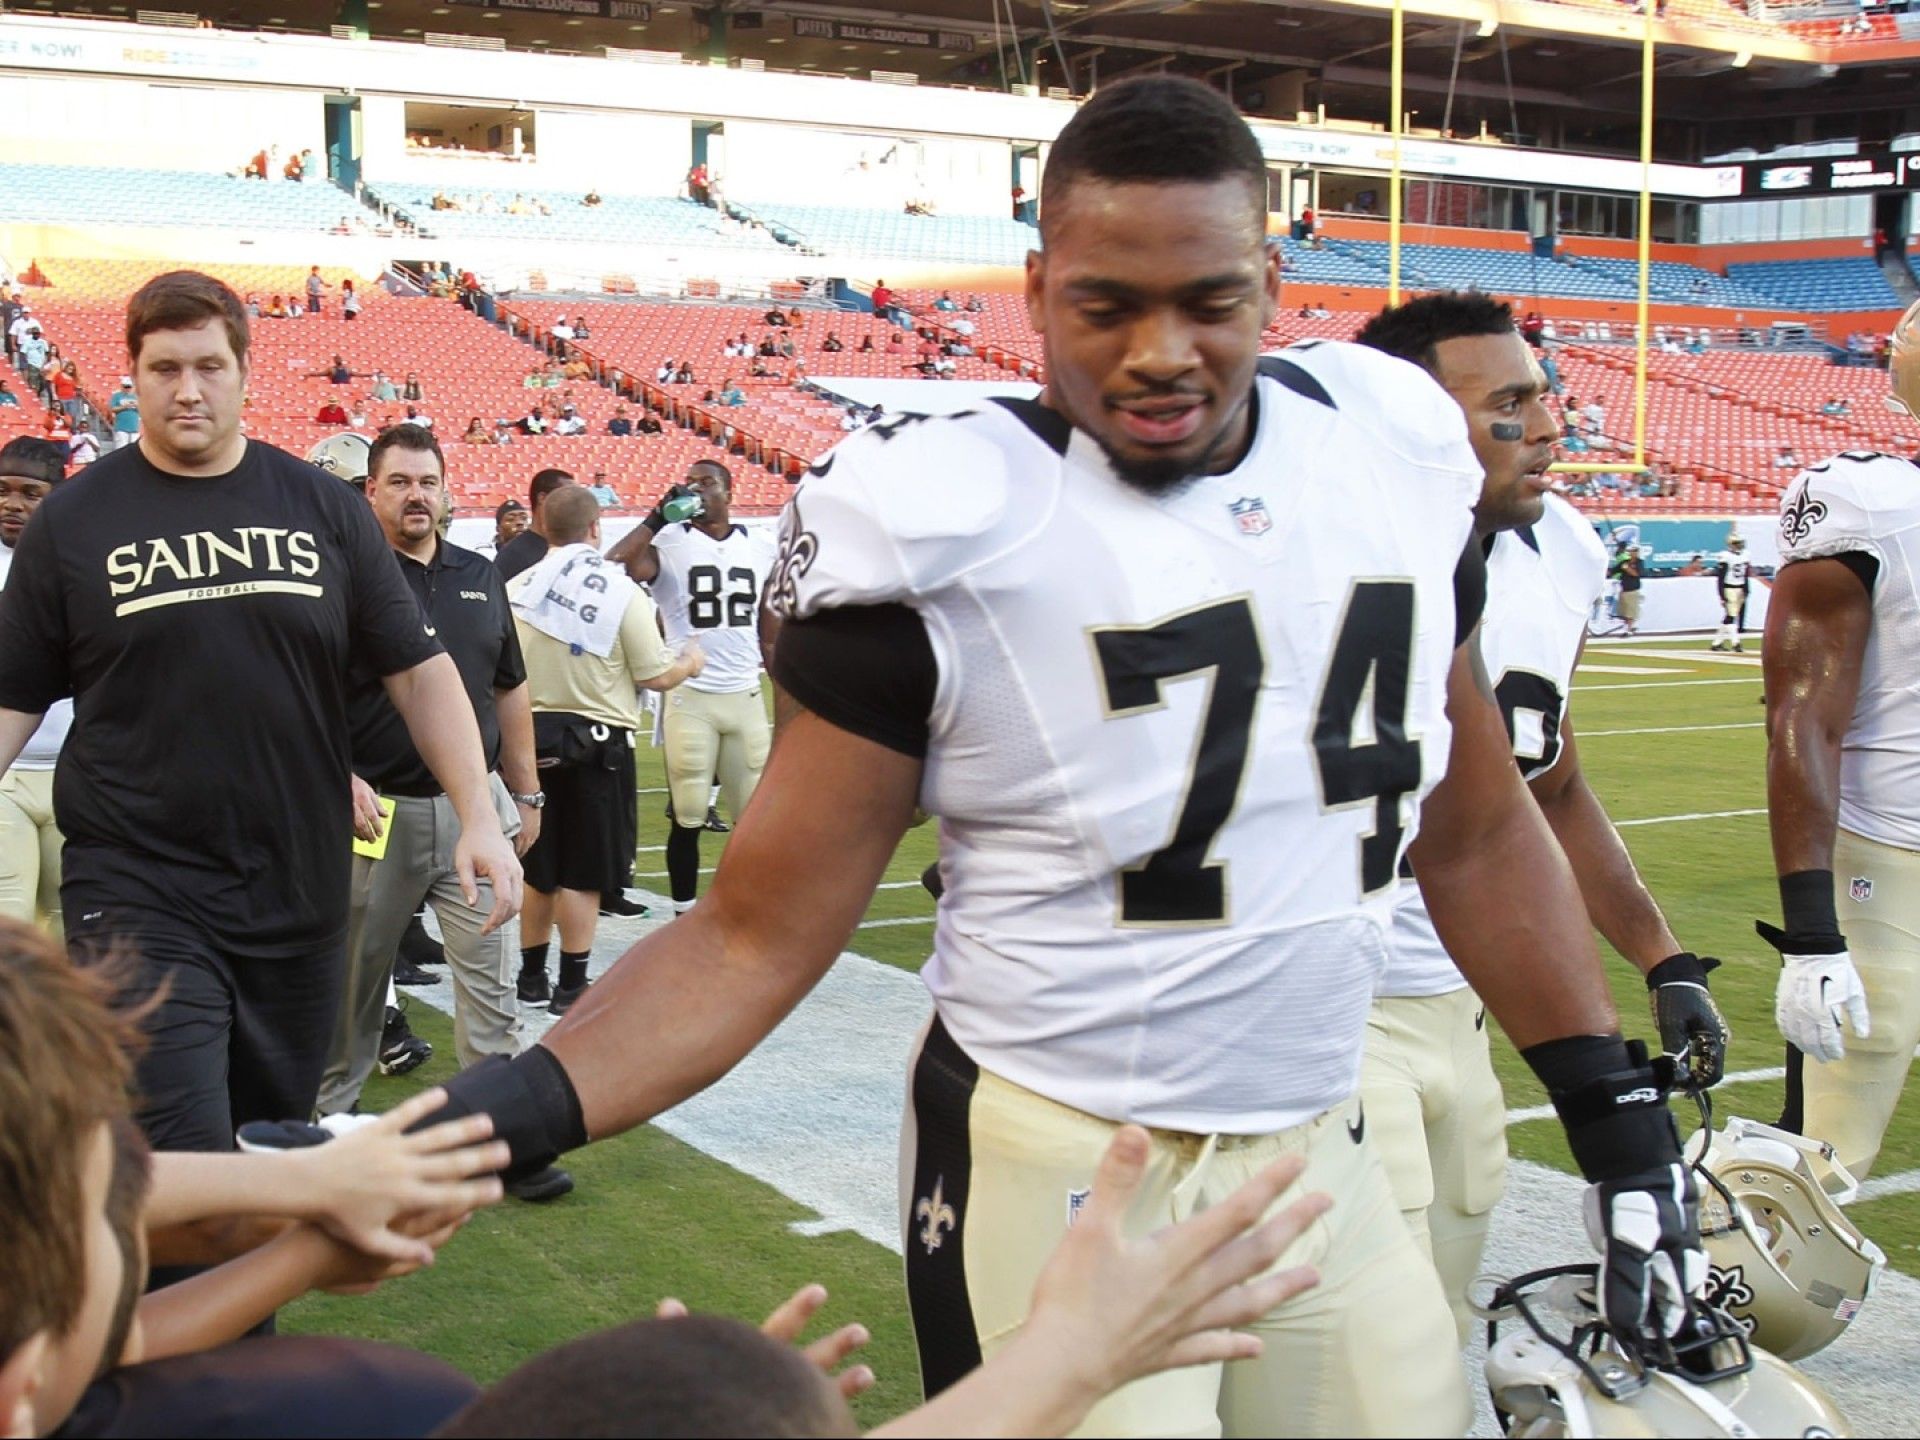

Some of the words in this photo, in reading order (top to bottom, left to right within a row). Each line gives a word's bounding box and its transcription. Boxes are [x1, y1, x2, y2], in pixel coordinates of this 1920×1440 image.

[106, 526, 321, 598] SAINTS
[188, 582, 259, 600] FOOTBALL
[579, 604, 598, 624] G
[688, 565, 756, 628] 82
[1083, 575, 1424, 930] 74
